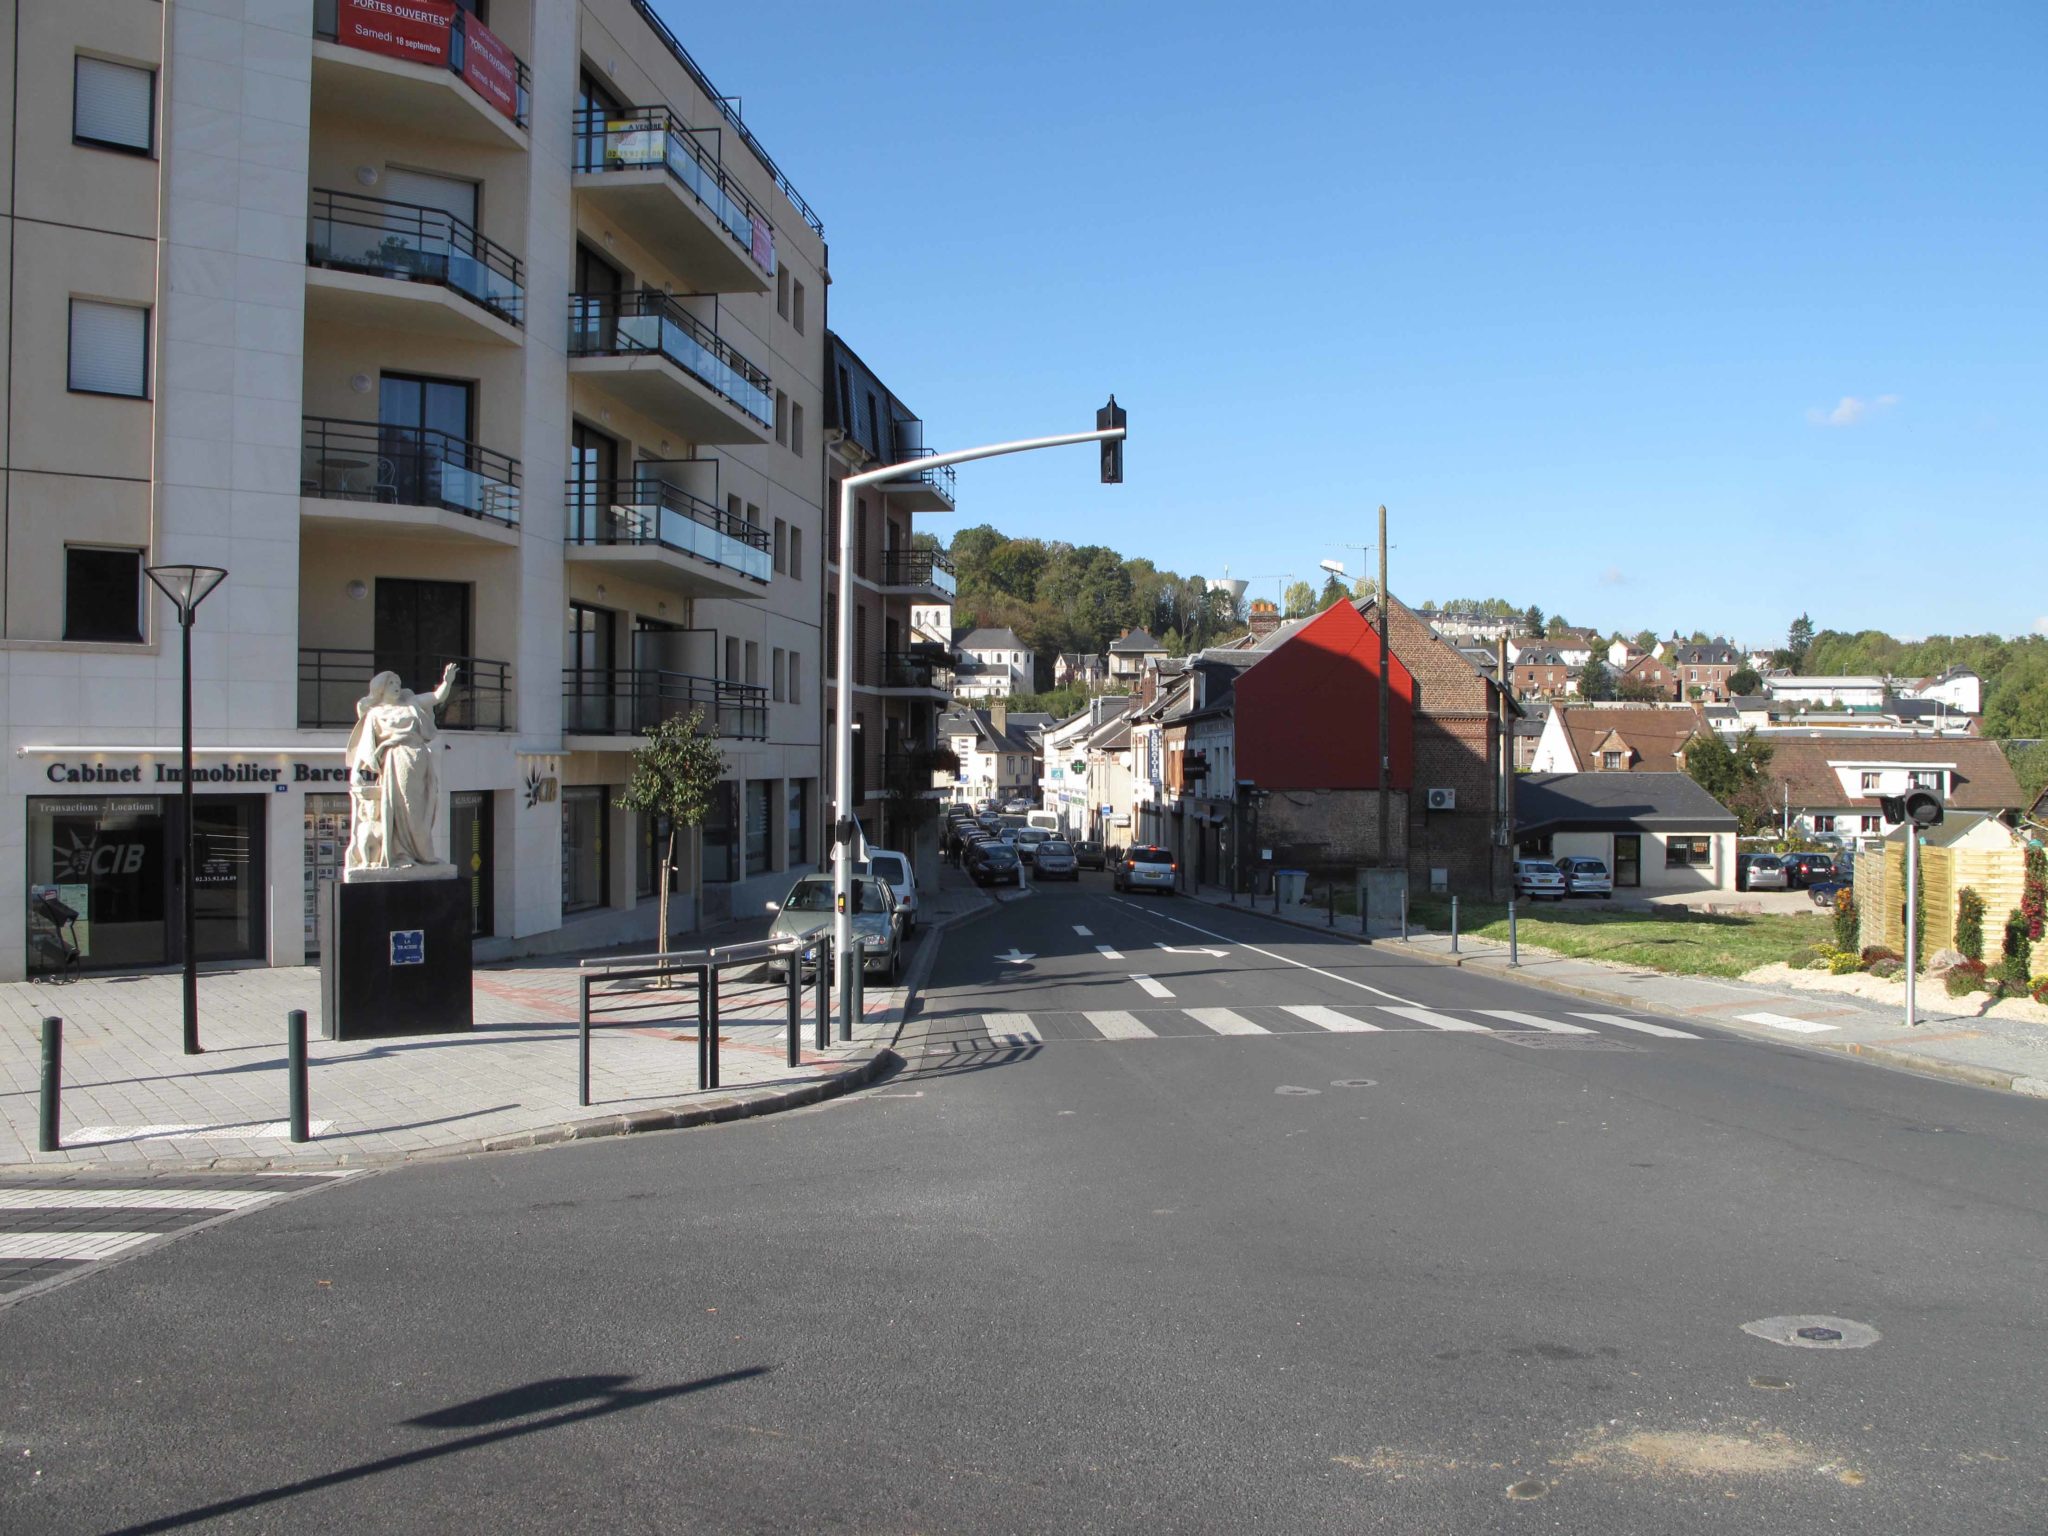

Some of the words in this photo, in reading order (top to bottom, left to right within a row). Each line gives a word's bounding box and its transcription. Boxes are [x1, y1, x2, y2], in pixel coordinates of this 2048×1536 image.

[355, 24, 392, 42] Samedi
[396, 36, 404, 46] 18
[405, 39, 441, 54] septembre
[47, 763, 141, 783] Cabinet
[155, 763, 282, 782] Immobilier
[39, 802, 98, 812] Transactions
[111, 802, 154, 812] Locations
[91, 844, 145, 875] CIB
